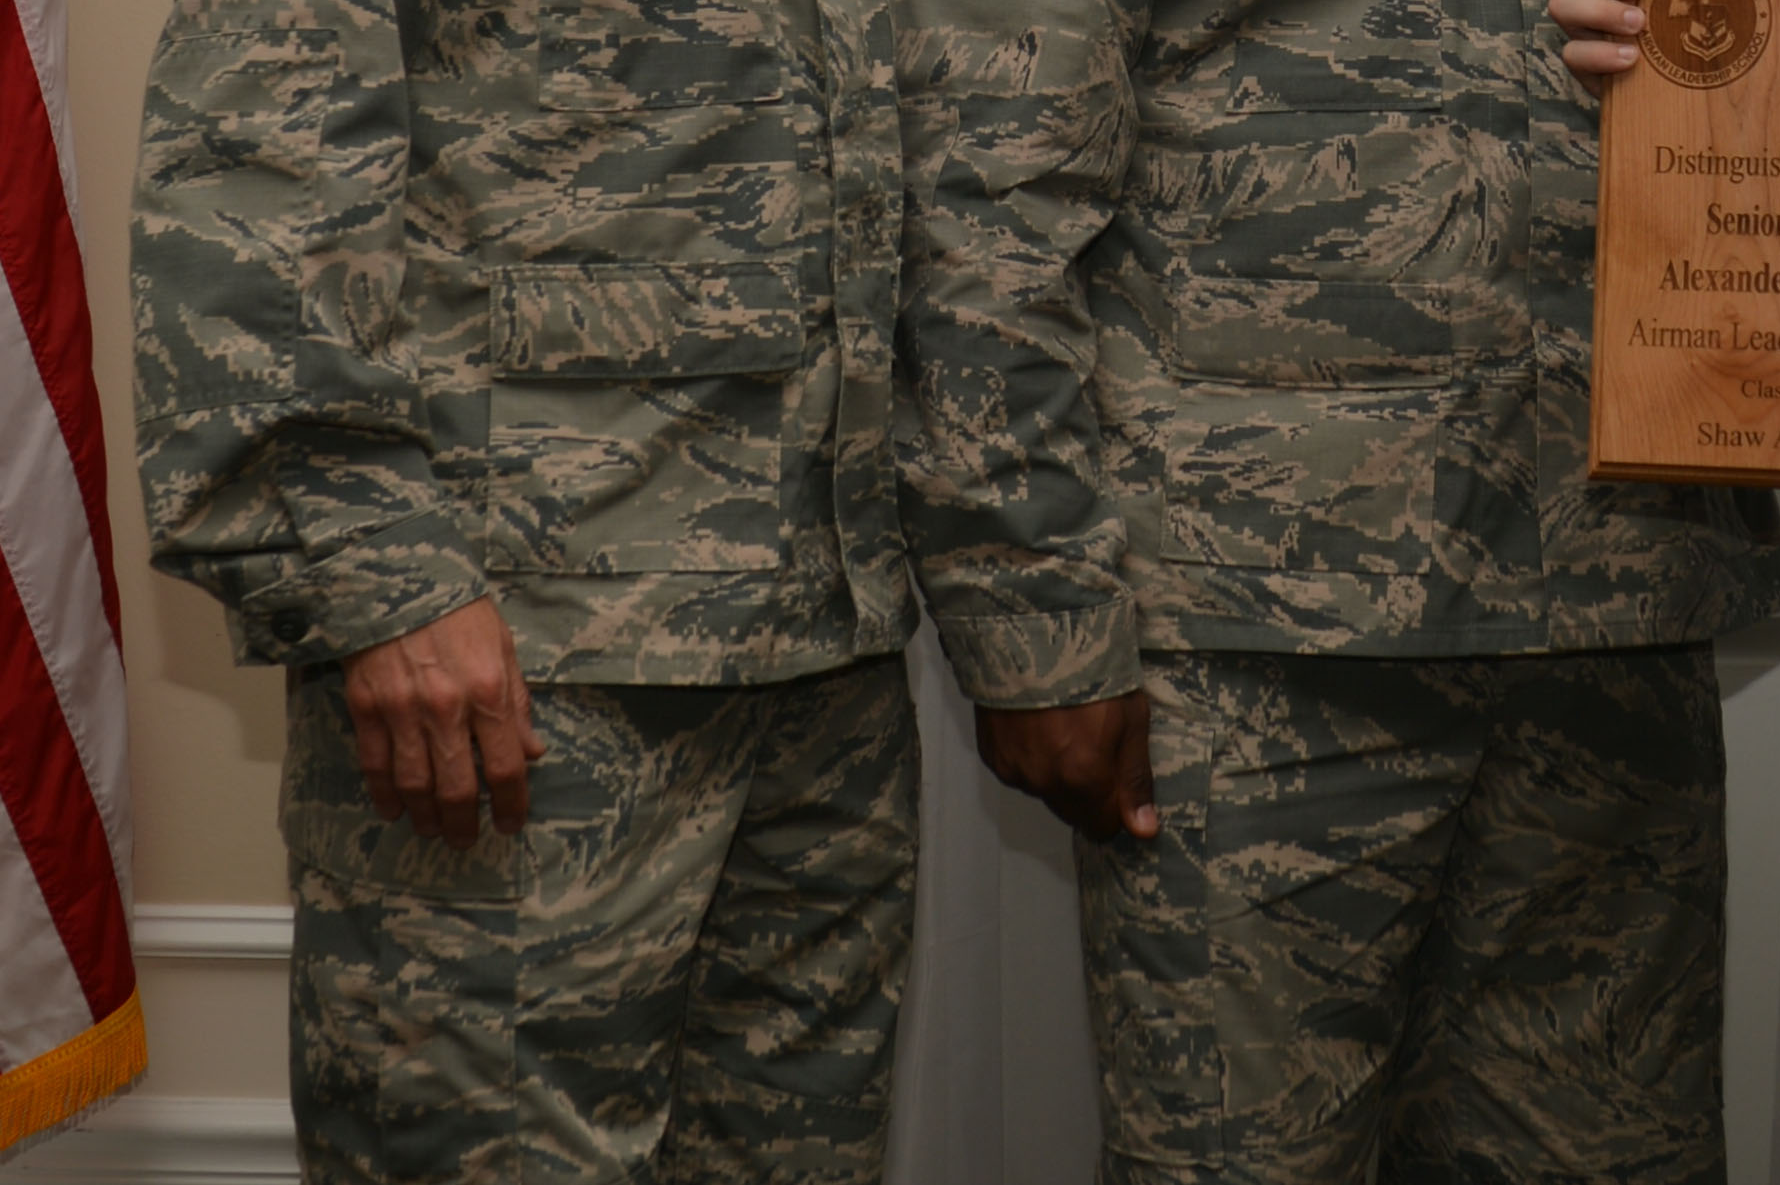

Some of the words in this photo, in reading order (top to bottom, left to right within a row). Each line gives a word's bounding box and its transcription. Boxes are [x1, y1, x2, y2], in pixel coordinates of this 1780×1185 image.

[1668, 65, 1732, 85] LEADERSHIP
[1734, 31, 1765, 73] SCHOOL
[1627, 318, 1722, 350] Airman
[1696, 421, 1766, 447] Shaw
